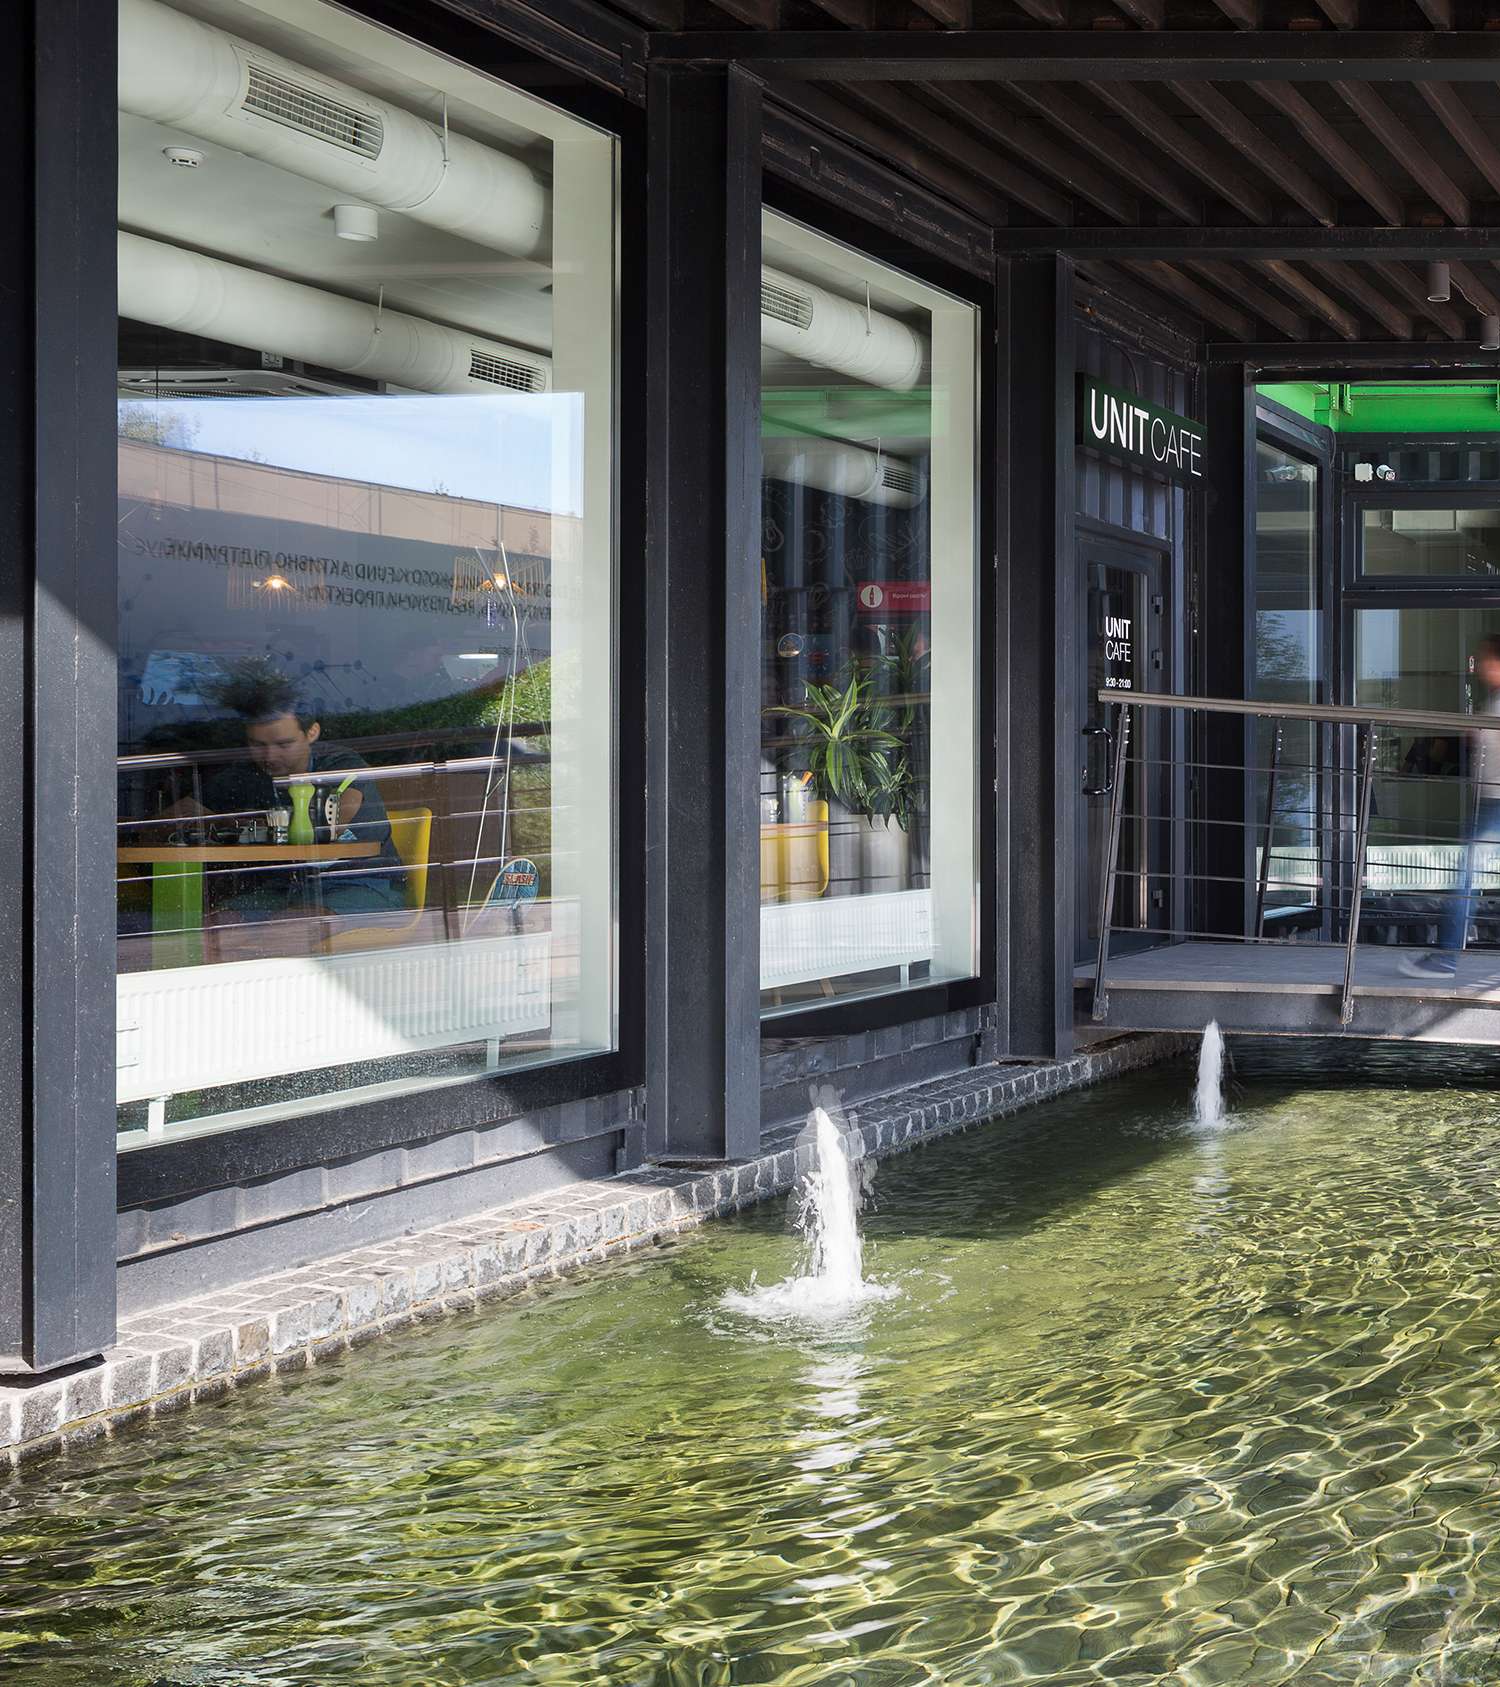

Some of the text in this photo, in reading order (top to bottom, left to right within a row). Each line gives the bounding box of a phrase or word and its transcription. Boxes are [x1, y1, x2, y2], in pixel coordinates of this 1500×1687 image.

[1091, 388, 1202, 477] UNIT CAFE
[1105, 616, 1131, 639] UNIT
[1105, 640, 1131, 662] CAFE
